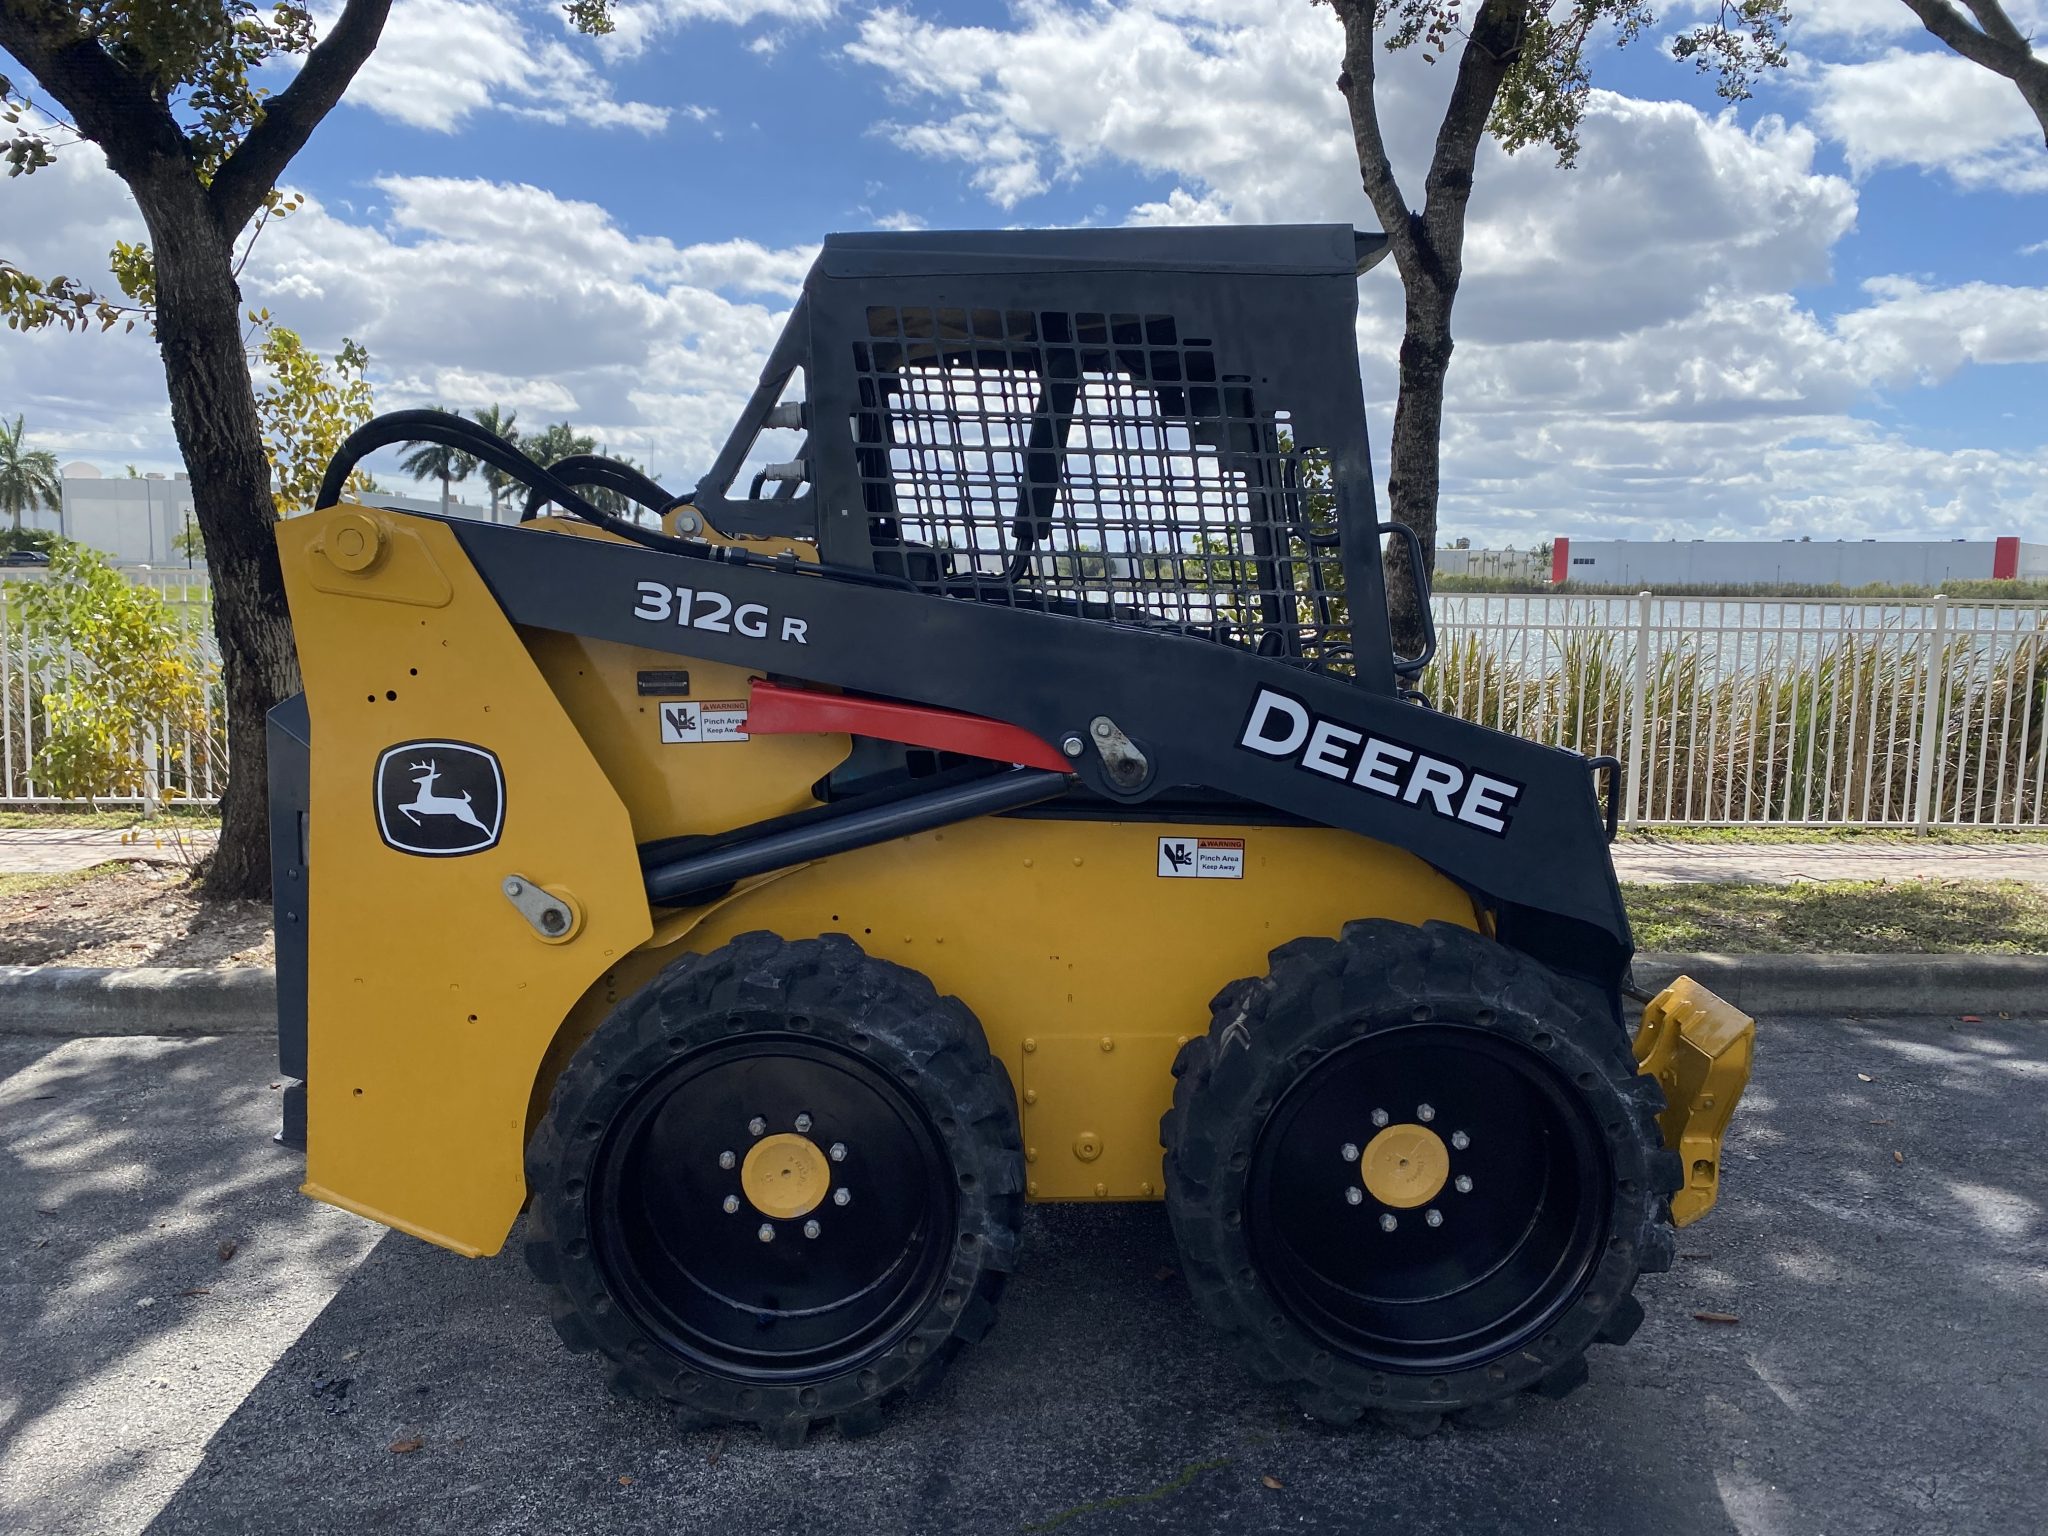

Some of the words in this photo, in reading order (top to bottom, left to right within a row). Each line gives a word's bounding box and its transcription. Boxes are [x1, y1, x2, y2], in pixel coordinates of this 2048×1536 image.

[634, 581, 768, 638] 312G
[781, 617, 808, 644] R
[1241, 689, 1519, 833] DEERE
